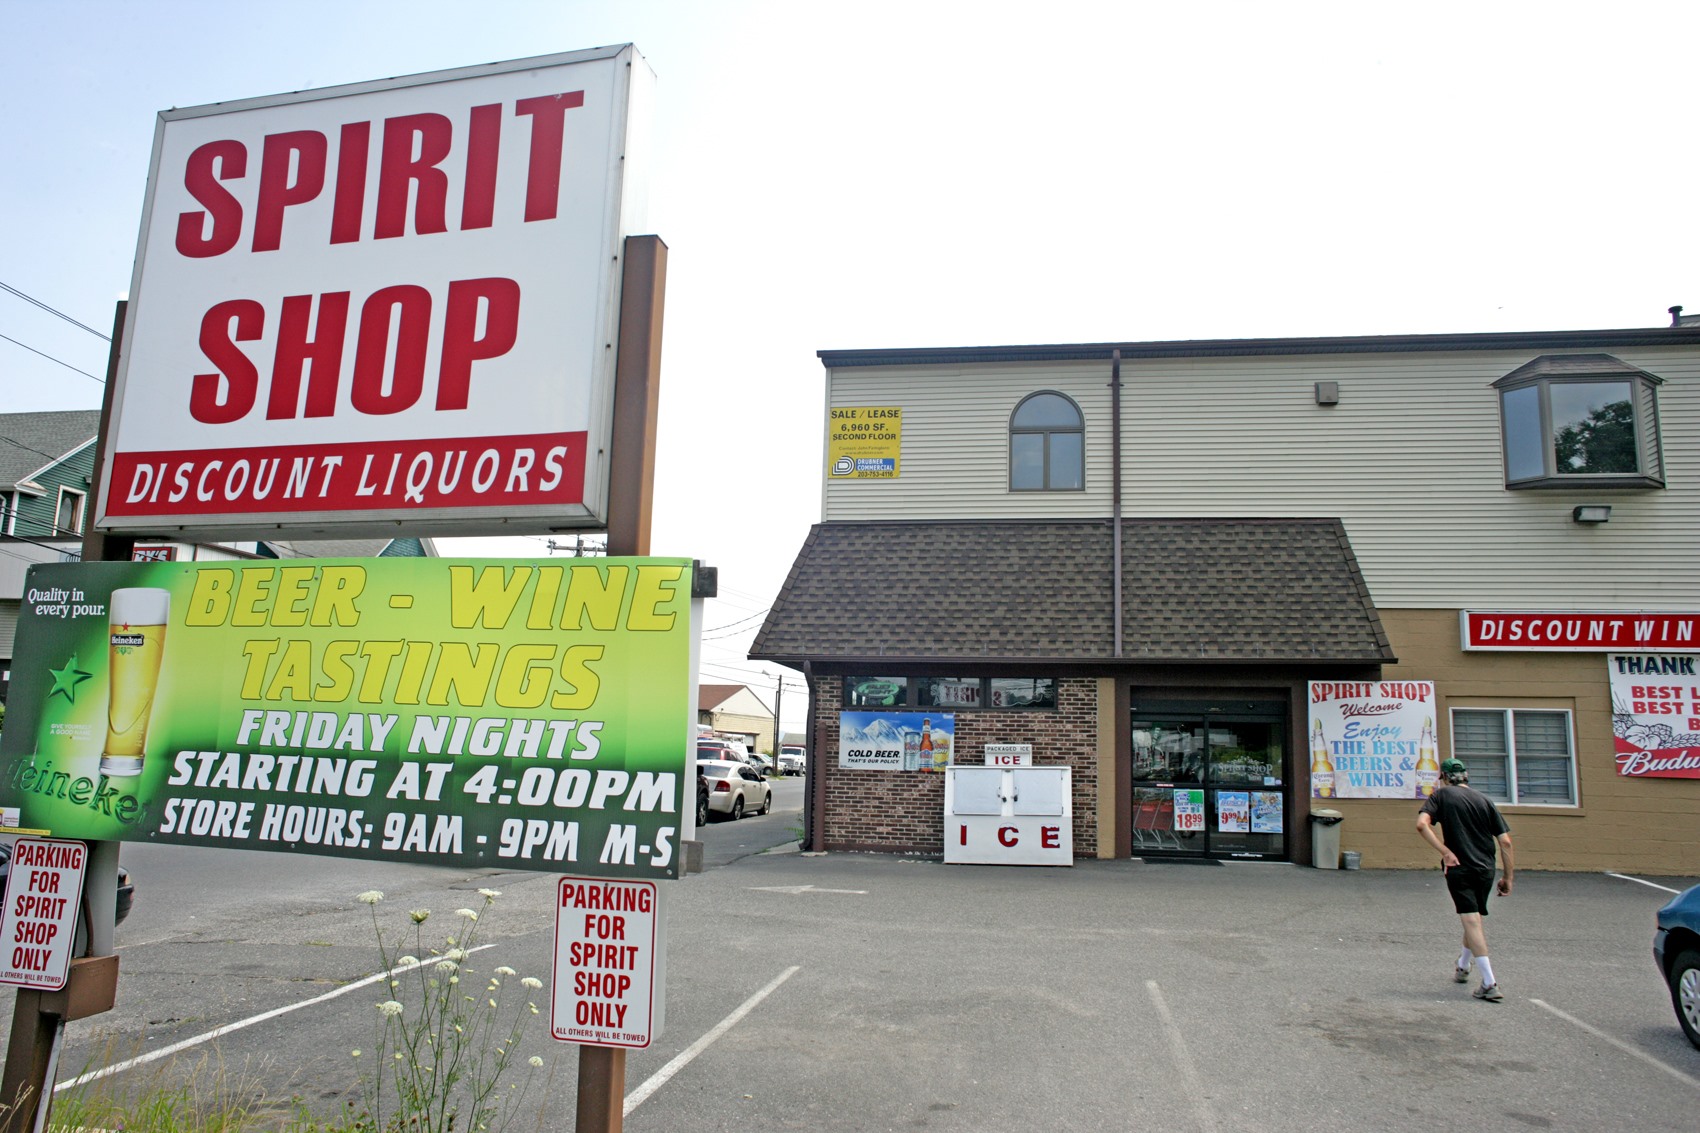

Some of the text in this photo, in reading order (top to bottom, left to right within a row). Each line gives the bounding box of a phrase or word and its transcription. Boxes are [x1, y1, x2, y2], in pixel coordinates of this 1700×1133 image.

[175, 90, 585, 259] SPIRIT
[189, 276, 521, 425] SHOP
[831, 410, 857, 419] SALE
[867, 409, 900, 418] LEASE
[841, 423, 889, 432] 6,960 SF.
[125, 446, 568, 504] DISCOUNT LIQUORS
[28, 588, 84, 604] Quality in
[185, 565, 686, 631] BEER - WINE
[36, 604, 106, 618] every pour.
[111, 636, 144, 645] Heineken
[1480, 619, 1694, 642] DISCOUNT WIN
[240, 638, 606, 711] TASTINGS
[1615, 656, 1696, 675] THANK
[1311, 682, 1431, 704] SPIRIT SHOP
[1631, 685, 1683, 699] BEST
[1339, 702, 1403, 718] Welcome
[1632, 701, 1685, 715] BEST
[236, 710, 604, 761] FRIDAY NIGHTS
[1343, 721, 1402, 741] Enjoy
[847, 749, 873, 757] COLD
[1330, 740, 1417, 755] THE BEST
[995, 755, 1021, 765] ICE
[1247, 763, 1273, 775] SHOP
[1335, 756, 1414, 771] BEERS &
[8, 758, 148, 825] eineke
[167, 751, 676, 814] STARTING AT 4:00PM
[1347, 772, 1404, 788] WINES
[160, 797, 675, 867] STORE HOURS: 9AM - 9PM M-S
[960, 825, 1060, 848] ICE
[15, 844, 82, 870] PARKING
[29, 871, 61, 894] FOR
[15, 894, 67, 920] SPIRIT
[562, 883, 651, 913] PARKING
[14, 921, 58, 945] SHOP
[584, 914, 625, 940] FOR
[12, 947, 52, 971] ONLY
[570, 941, 639, 970] SPIRIT
[4, 971, 23, 980] OTHERS
[44, 975, 61, 983] TOWED
[574, 971, 631, 999] SHOP
[575, 1000, 628, 1028] ONLY
[555, 1027, 567, 1035] ALL
[568, 1028, 593, 1037] OTHERS
[595, 1030, 611, 1038] WILL
[622, 1033, 645, 1042] TOWED
